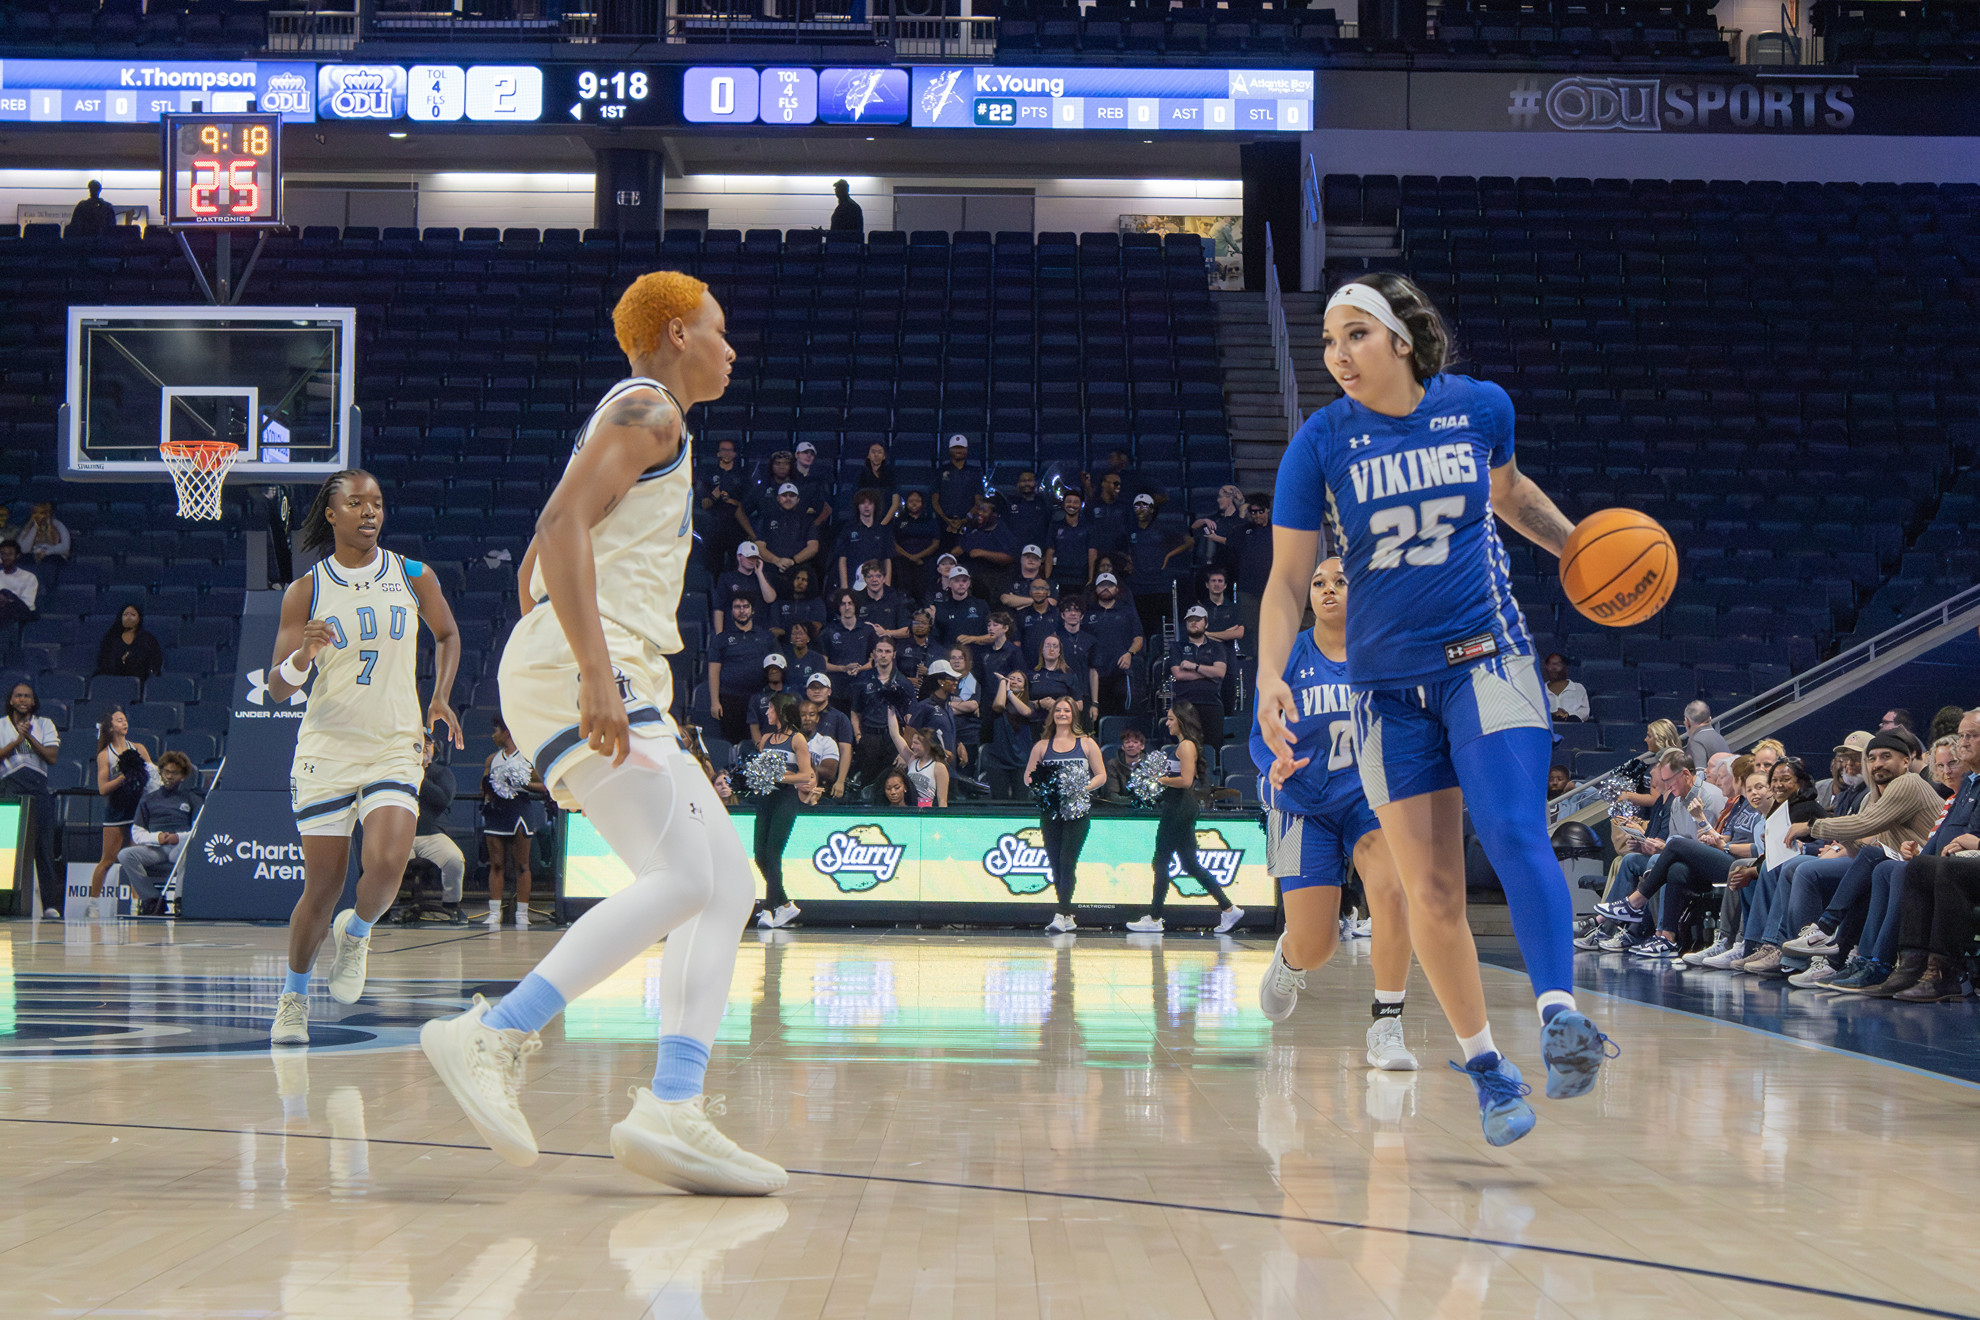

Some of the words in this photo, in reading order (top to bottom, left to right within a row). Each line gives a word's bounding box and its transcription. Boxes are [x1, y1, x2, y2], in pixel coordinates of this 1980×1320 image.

[121, 67, 257, 92] K.Thompson
[426, 69, 447, 79] TOL
[578, 71, 649, 99] 9:18
[777, 71, 800, 83] TOL
[1249, 77, 1290, 88] Atlantic
[431, 80, 441, 93] 4
[494, 74, 517, 113] 2
[710, 76, 735, 115] 0
[783, 83, 794, 96] 4
[976, 74, 1064, 98] K.Young
[0, 98, 27, 111] REB
[43, 97, 50, 114] 1
[74, 99, 101, 112] AST
[115, 97, 128, 115] 0
[150, 100, 176, 112] STL
[262, 90, 311, 113] ODU
[333, 88, 392, 117] ODU
[426, 96, 446, 105] FLS
[599, 105, 627, 118] 1ST
[778, 97, 799, 109] FLS
[431, 106, 441, 118] 0
[783, 109, 793, 121] 0
[977, 102, 1013, 121] #22
[1021, 106, 1048, 118] PTS
[1062, 105, 1074, 121] 0
[1097, 107, 1124, 119] REB
[1137, 105, 1150, 122] 0
[1172, 108, 1199, 120] AST
[1213, 106, 1225, 122] 0
[1249, 108, 1274, 120] STL
[1287, 107, 1299, 124] 0
[200, 125, 269, 155] 9:18
[190, 160, 259, 213] 25
[1429, 414, 1470, 432] CIAA
[1348, 442, 1478, 504] VIKINGS
[1368, 495, 1466, 571] 25
[381, 582, 402, 592] SBC
[1588, 569, 1658, 618] Wilson
[355, 650, 379, 686] 7
[814, 831, 903, 881] Starry
[985, 834, 1054, 883] Star
[253, 861, 305, 880] Aren
